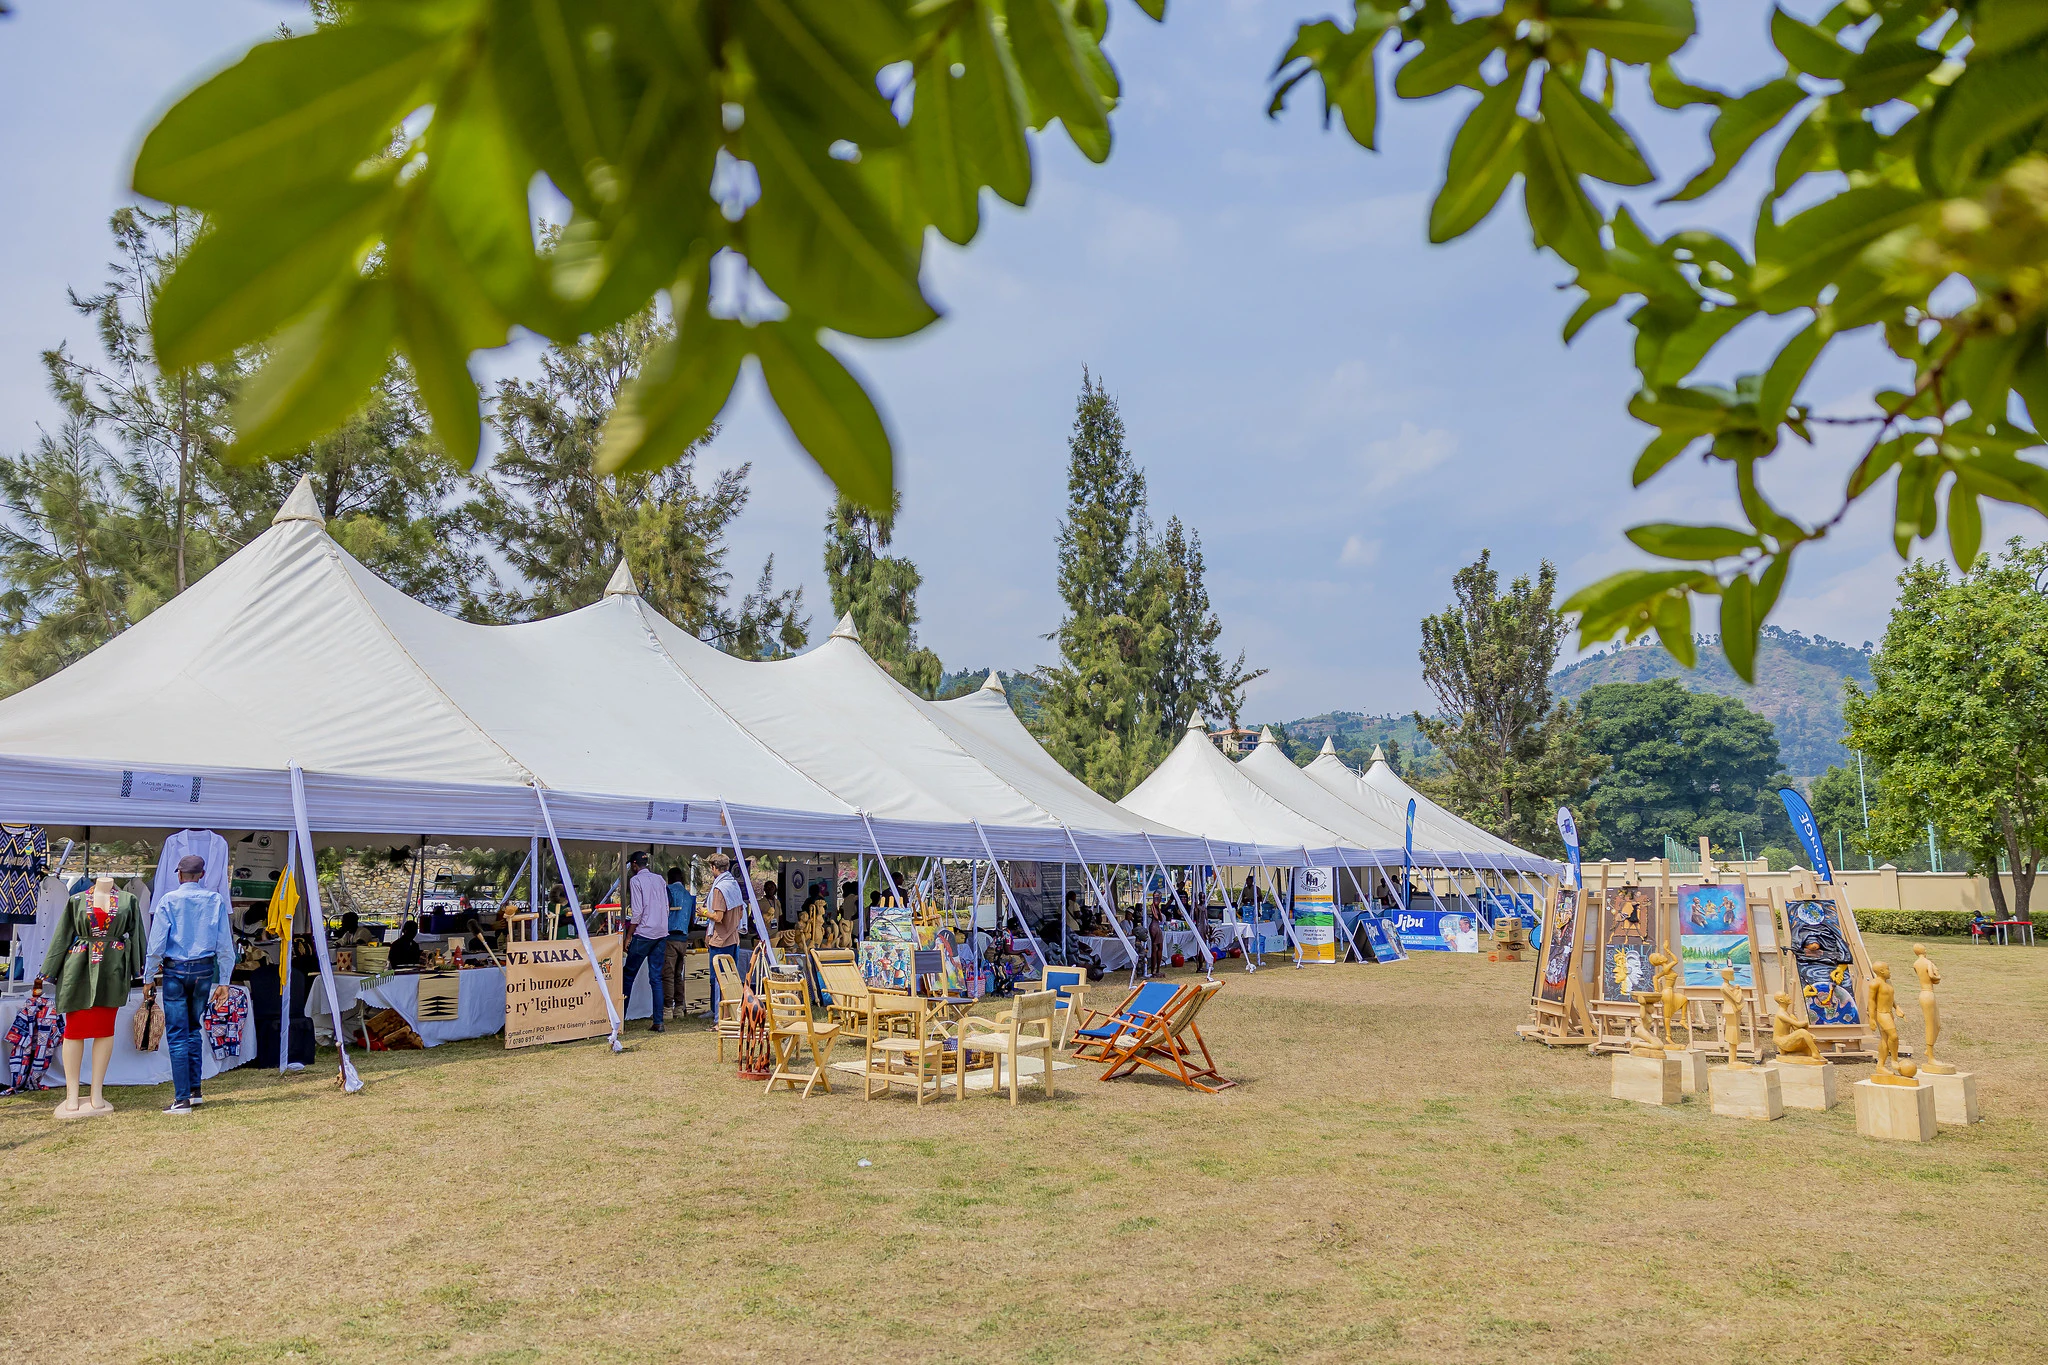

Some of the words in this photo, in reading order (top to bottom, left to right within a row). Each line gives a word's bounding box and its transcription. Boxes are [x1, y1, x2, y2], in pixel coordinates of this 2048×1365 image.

[1395, 914, 1424, 932] Jibu
[507, 952, 529, 966] VE
[532, 949, 583, 964] KIAKA
[530, 977, 575, 991] bunoze
[590, 1018, 607, 1026] Rwanda
